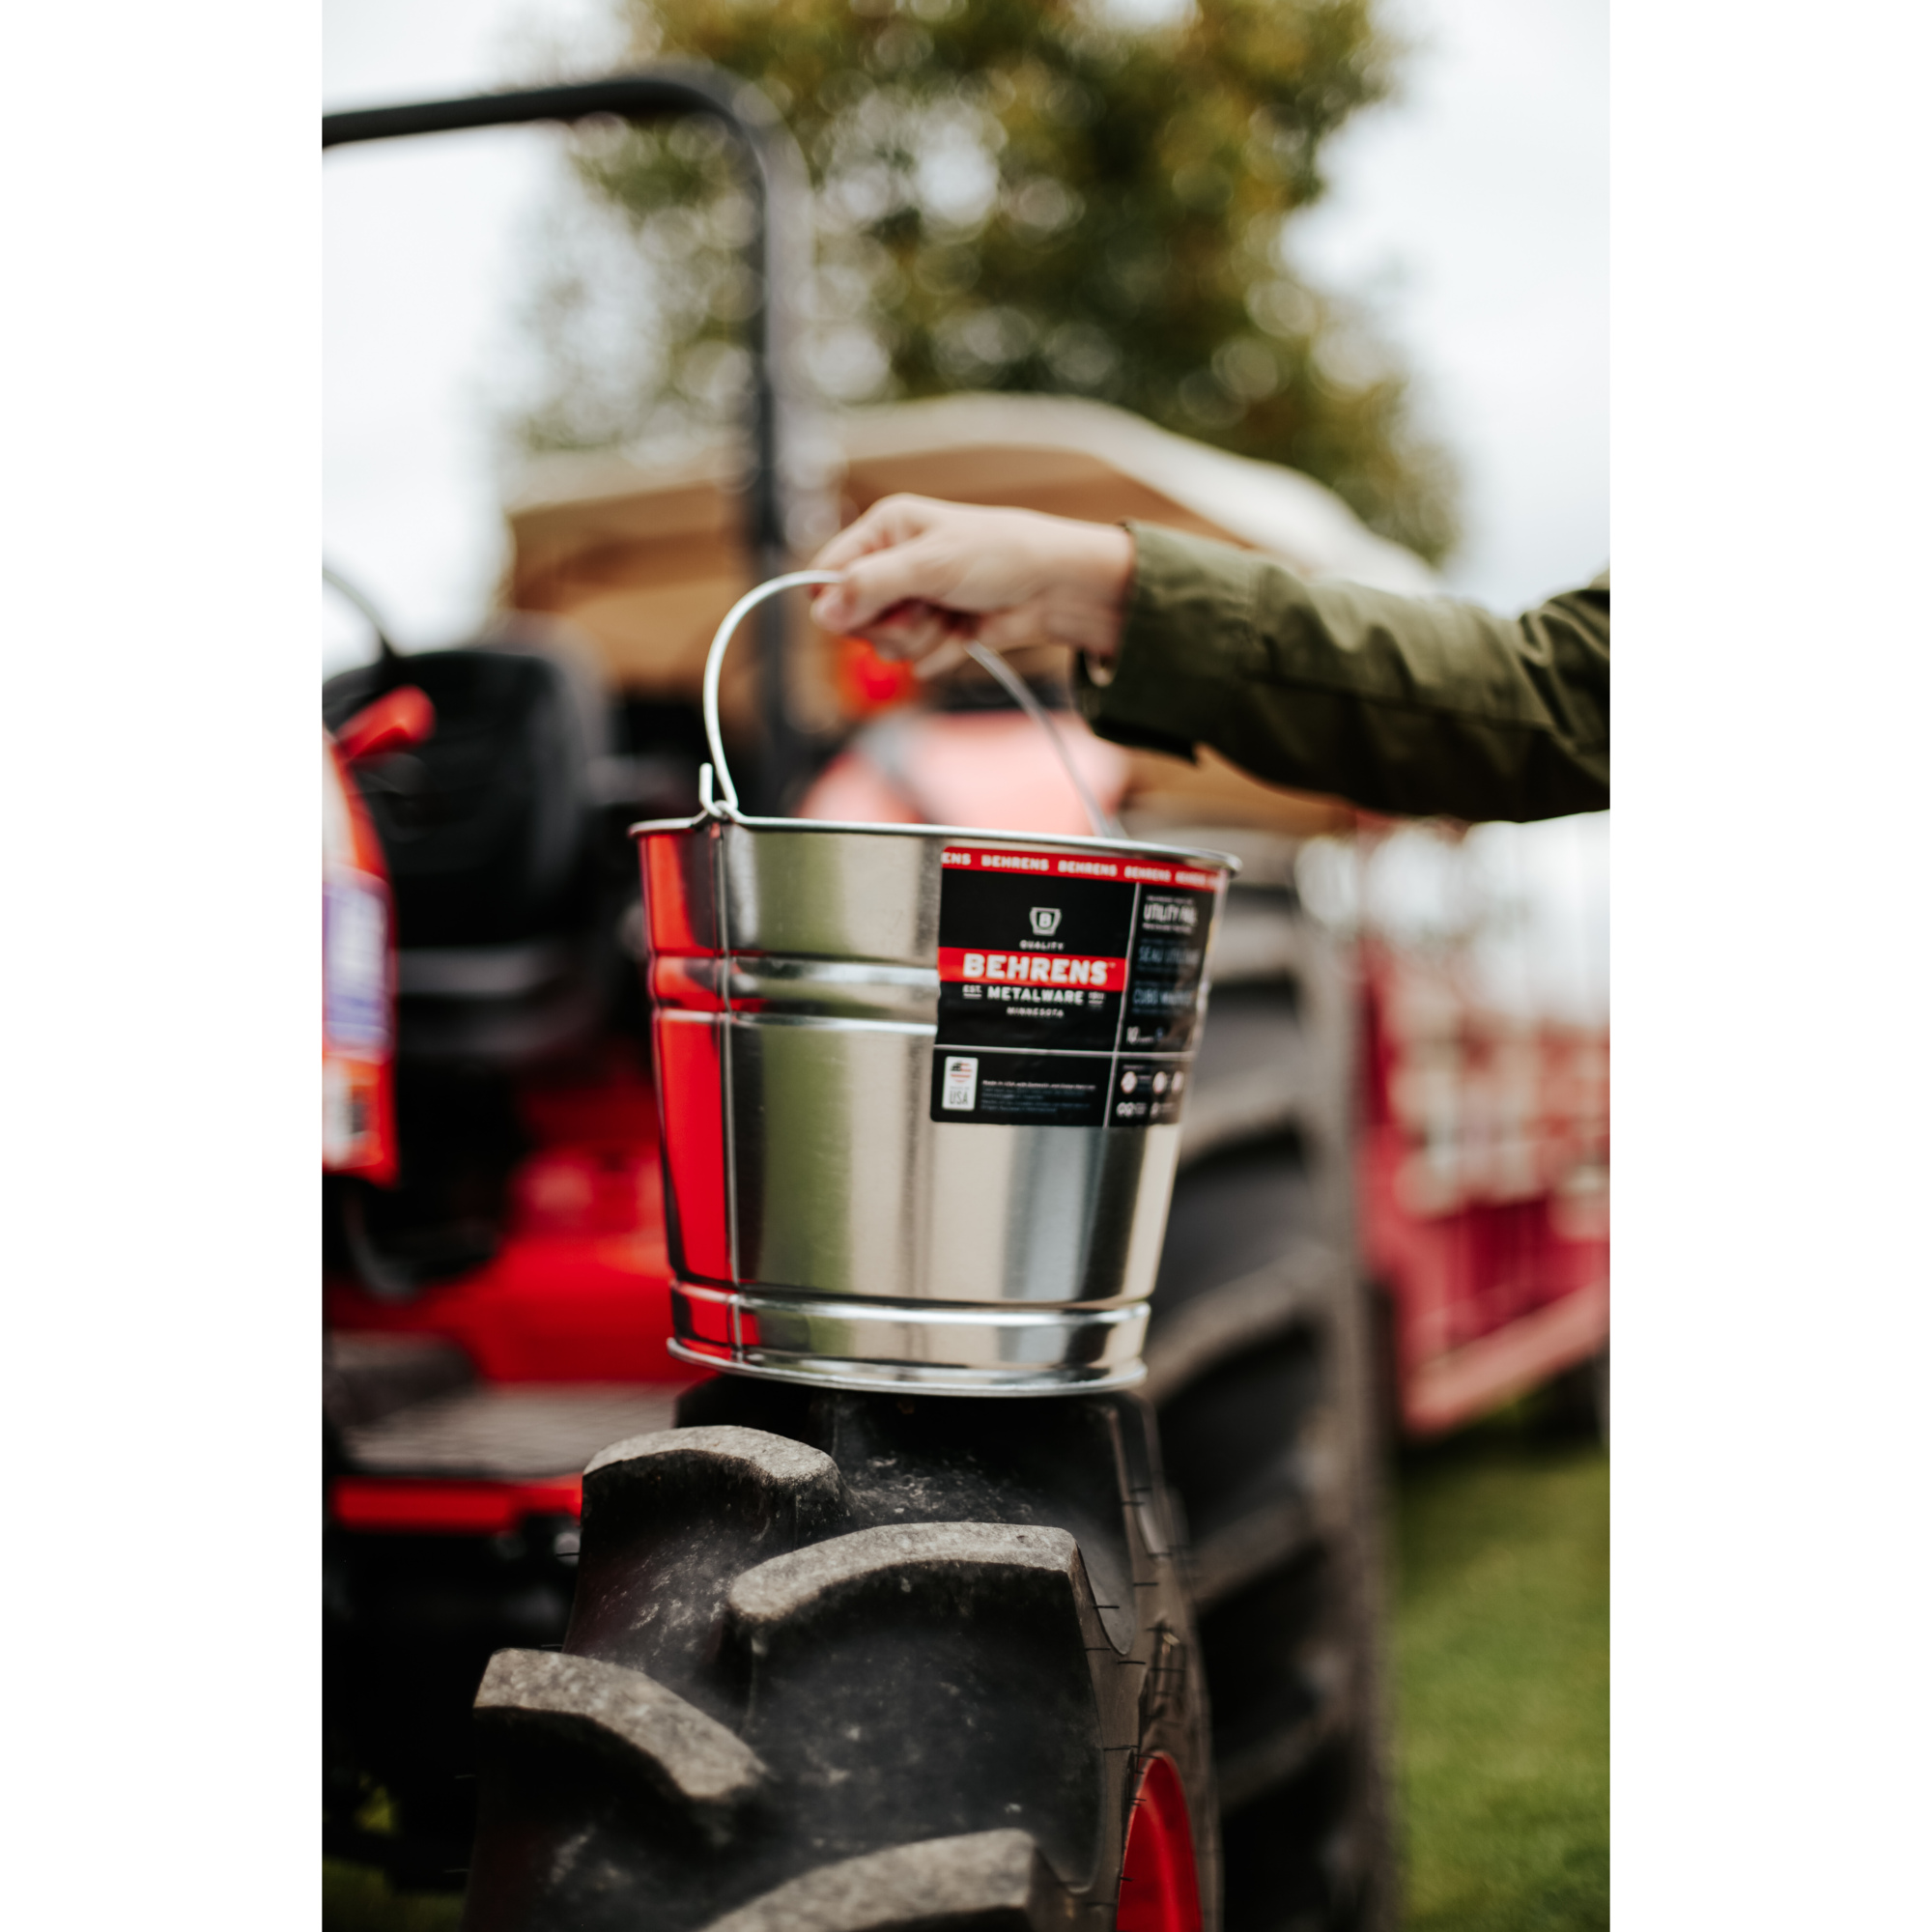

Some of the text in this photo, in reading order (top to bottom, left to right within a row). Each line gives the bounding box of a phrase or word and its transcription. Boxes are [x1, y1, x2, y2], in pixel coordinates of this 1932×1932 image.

[981, 855, 1049, 871] BEHRENS
[1058, 860, 1118, 877] BEHRENS
[1123, 866, 1172, 882] BEHRENS
[1019, 940, 1064, 951] QUALITY
[963, 952, 1108, 985] BEHRENS
[987, 985, 1084, 1005] METALWARE
[1007, 1007, 1064, 1017] MINNESOTA
[950, 1091, 968, 1105] USA
